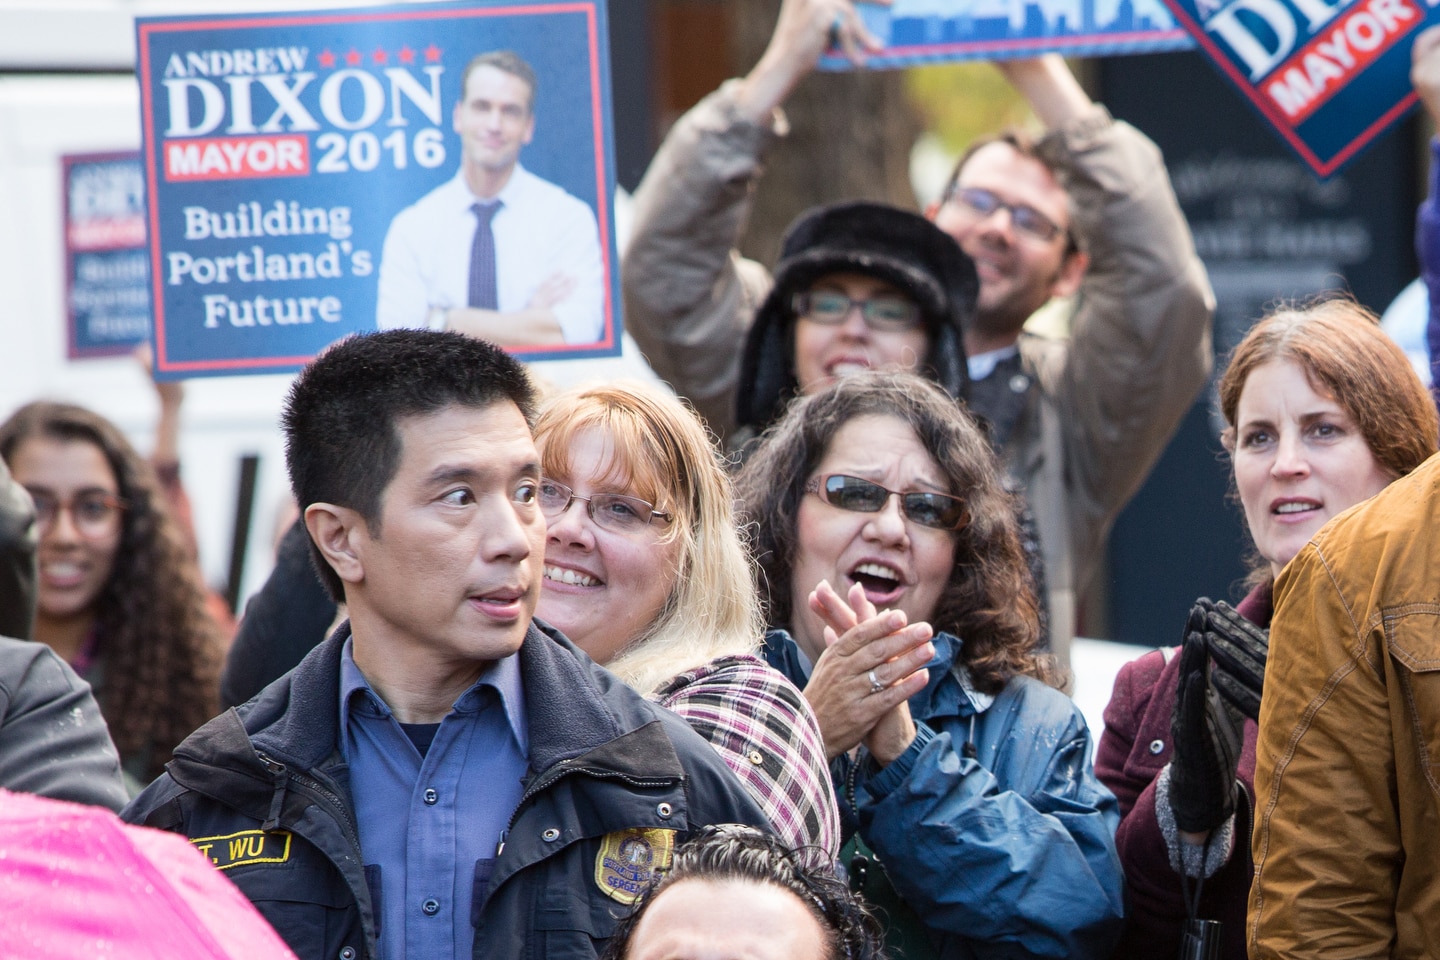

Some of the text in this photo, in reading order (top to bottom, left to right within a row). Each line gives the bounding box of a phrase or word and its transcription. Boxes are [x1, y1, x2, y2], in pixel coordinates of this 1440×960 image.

[166, 47, 308, 77] ANDREW
[1268, 0, 1414, 116] MAYOR
[162, 65, 446, 137] DIXON
[168, 127, 447, 176] MAYOR 2016
[183, 200, 353, 240] Building
[167, 240, 373, 285] Portland's
[203, 294, 342, 328] Future
[229, 836, 265, 861] WU
